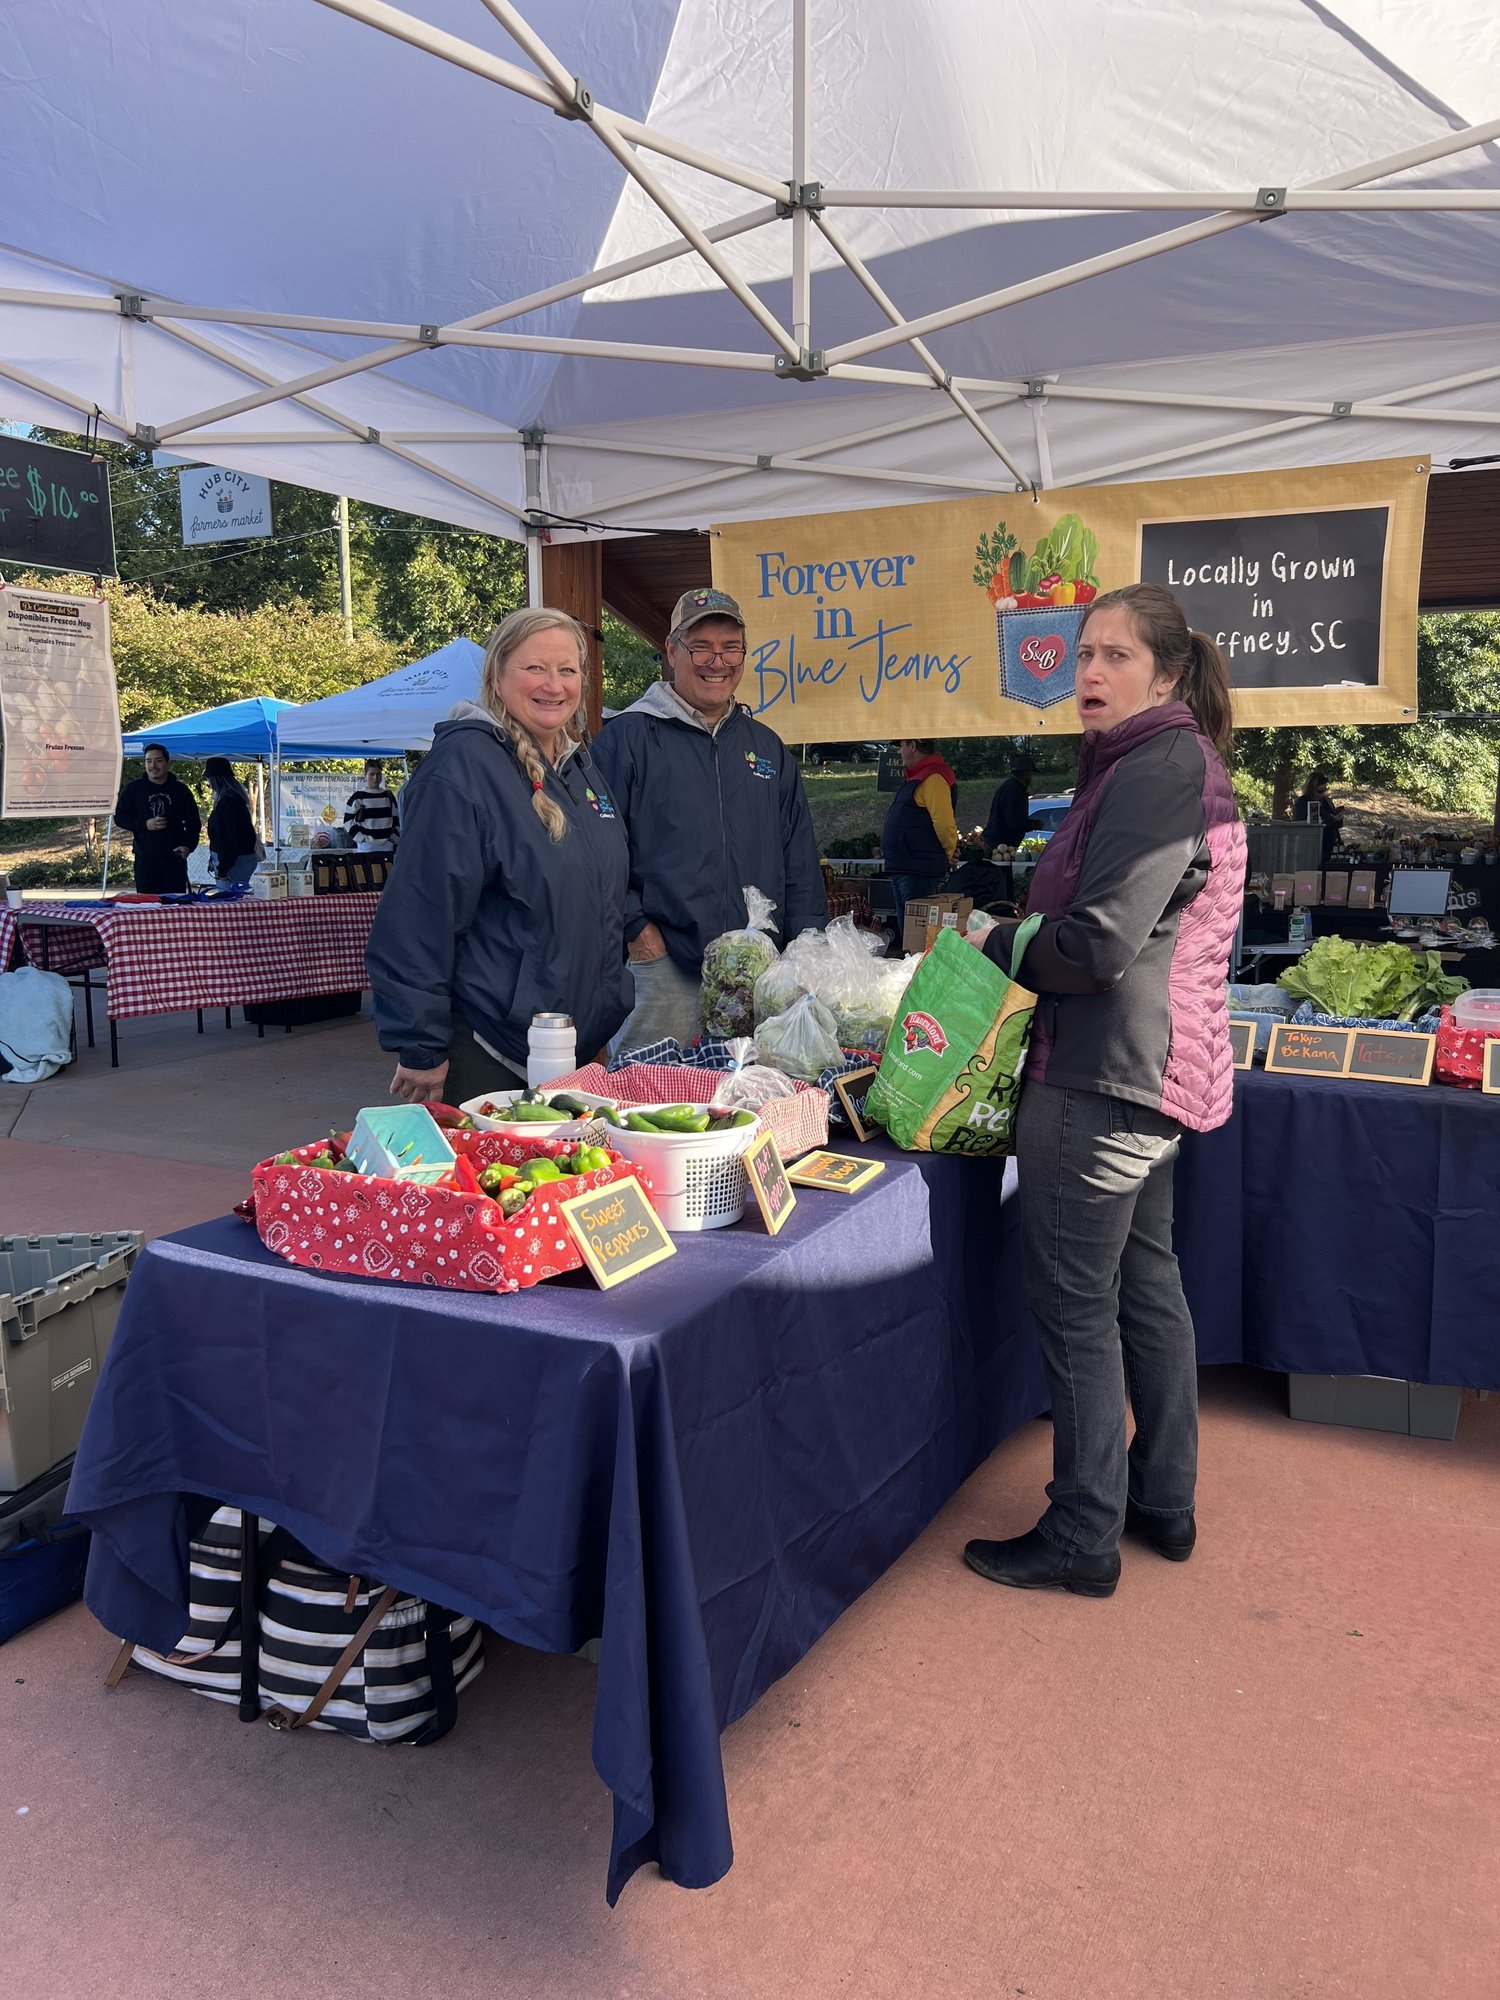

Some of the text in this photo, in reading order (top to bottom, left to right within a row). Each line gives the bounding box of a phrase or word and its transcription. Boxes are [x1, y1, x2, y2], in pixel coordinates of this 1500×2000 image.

[198, 471, 250, 500] HUB CITY
[190, 509, 263, 539] farmers market
[756, 552, 915, 598] Forever
[1168, 551, 1355, 586] Locally Grown
[8, 610, 49, 623] Disponibles
[50, 616, 76, 626] Frescos
[78, 620, 91, 629] Hoy
[813, 596, 856, 640] in
[1252, 593, 1274, 618] in
[28, 637, 54, 645] Vegetales
[1213, 620, 1346, 658] ffney, SC
[747, 619, 972, 716] Blue Jeans
[909, 1014, 944, 1044] Hannaford
[1285, 1031, 1322, 1046] Tokyo
[763, 1175, 786, 1214] Peppers
[580, 1196, 626, 1231] Sweet
[591, 1219, 650, 1263] Peppers
